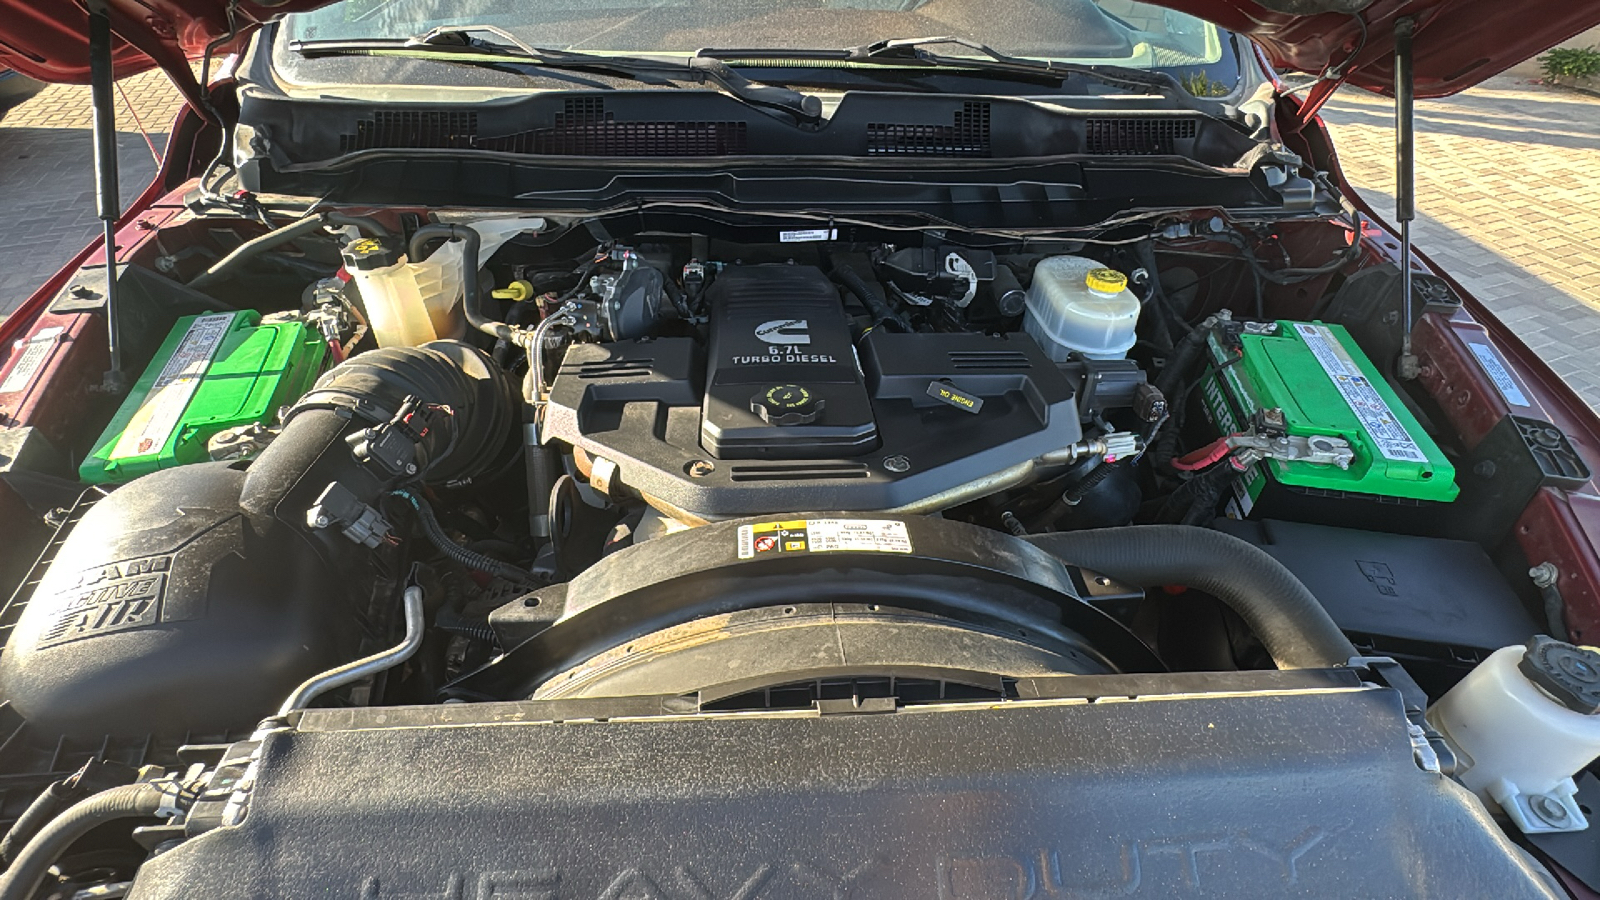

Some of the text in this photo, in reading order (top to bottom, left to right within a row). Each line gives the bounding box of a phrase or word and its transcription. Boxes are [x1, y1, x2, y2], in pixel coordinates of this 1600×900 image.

[768, 345, 803, 355] 6.7L
[732, 354, 837, 364] TURBO DIESEL
[936, 820, 1354, 900] DUTY
